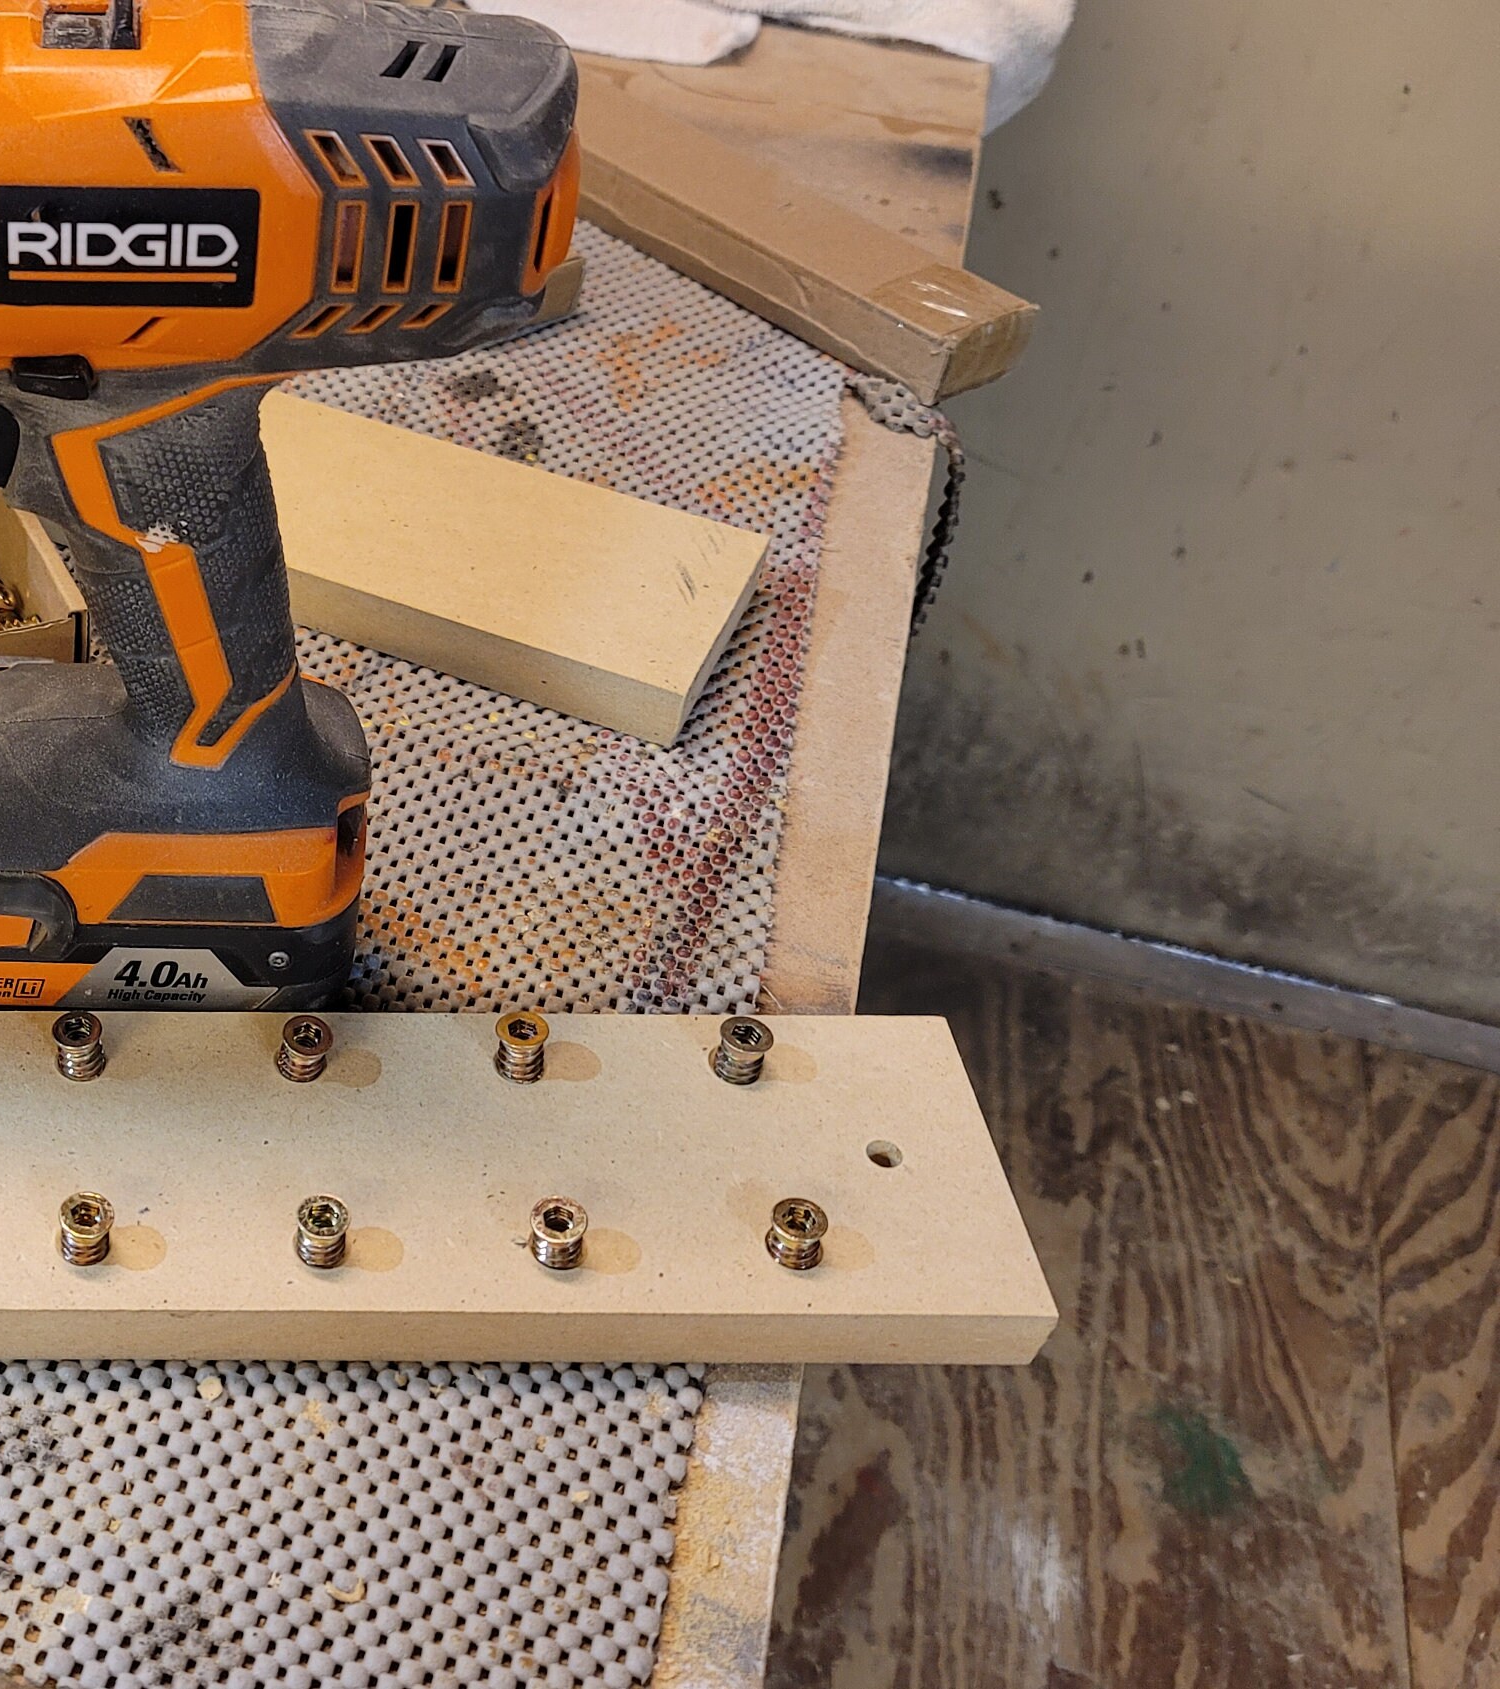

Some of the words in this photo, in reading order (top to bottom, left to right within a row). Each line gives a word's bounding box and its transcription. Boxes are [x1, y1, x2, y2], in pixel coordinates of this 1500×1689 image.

[114, 960, 208, 988] 4.0Ah
[107, 989, 140, 1001] High
[143, 990, 206, 1003] Capacity
